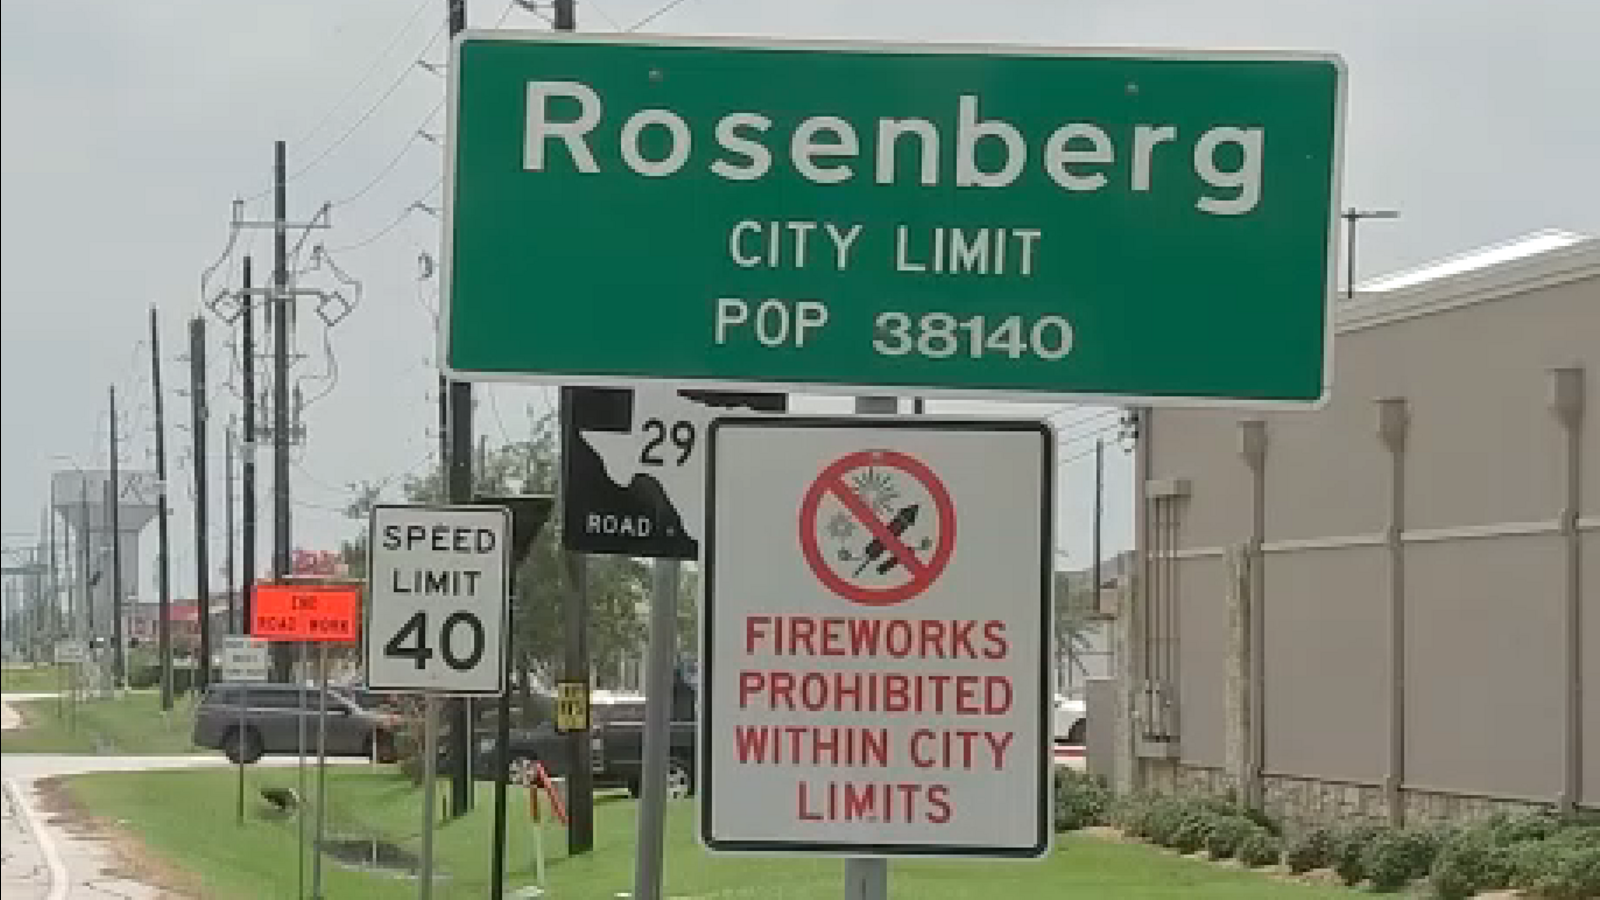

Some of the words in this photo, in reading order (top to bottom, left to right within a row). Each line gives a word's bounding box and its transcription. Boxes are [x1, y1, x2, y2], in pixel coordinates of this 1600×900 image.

[522, 80, 1266, 215] Rosenberg
[730, 220, 863, 269] CITY
[896, 224, 1043, 276] LIMIT
[714, 298, 828, 346] POP
[872, 312, 1075, 360] 38140
[382, 525, 496, 555] SPEED
[586, 514, 652, 537] ROAD
[393, 570, 482, 598] LIMIT
[384, 610, 487, 671] 40
[746, 616, 1008, 658] FIREWORKS
[739, 672, 1014, 715] PROHIBITED
[734, 725, 892, 767] WITHIN
[908, 730, 1013, 770] CITY
[797, 780, 953, 824] LIMITS
